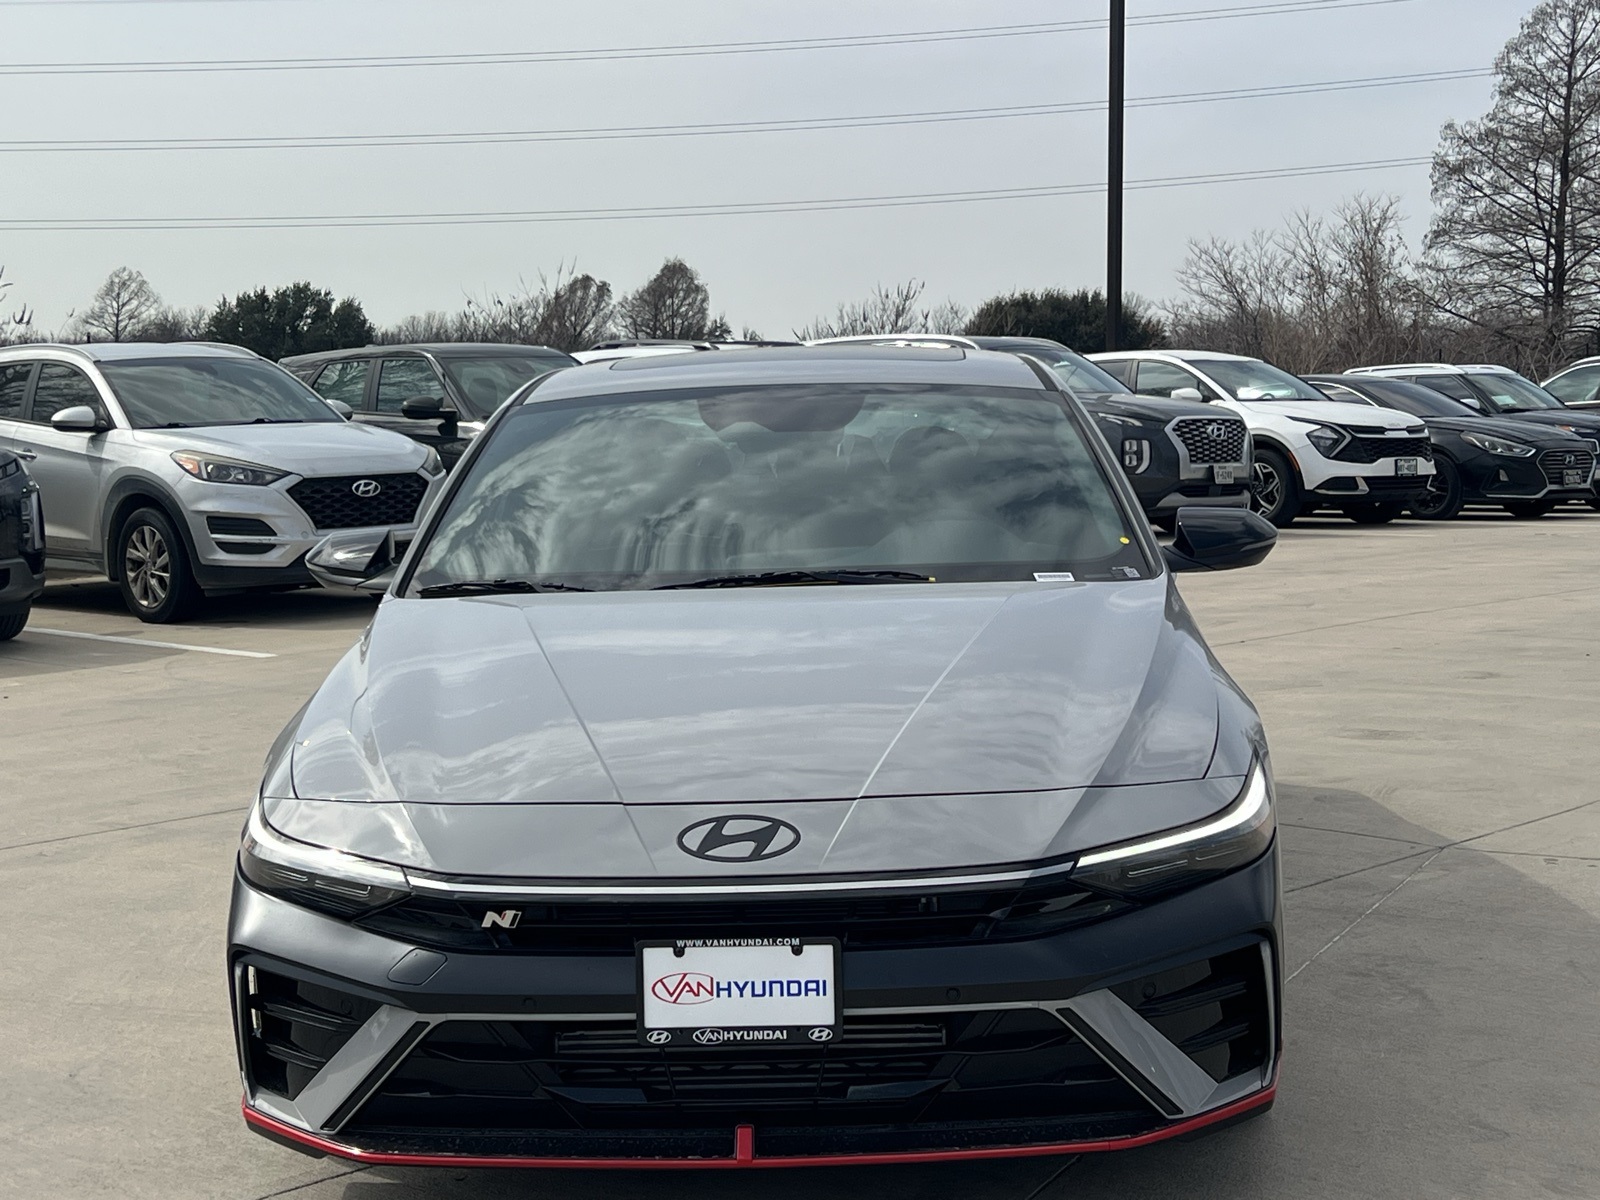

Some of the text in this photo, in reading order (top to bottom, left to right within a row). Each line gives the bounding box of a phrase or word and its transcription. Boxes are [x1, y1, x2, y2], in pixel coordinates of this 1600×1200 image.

[676, 938, 800, 948] WWW.VANHYUNDAI.COM
[658, 973, 827, 1004] VAN HYUNDAI
[695, 1029, 787, 1044] VAN HYUNDAI
